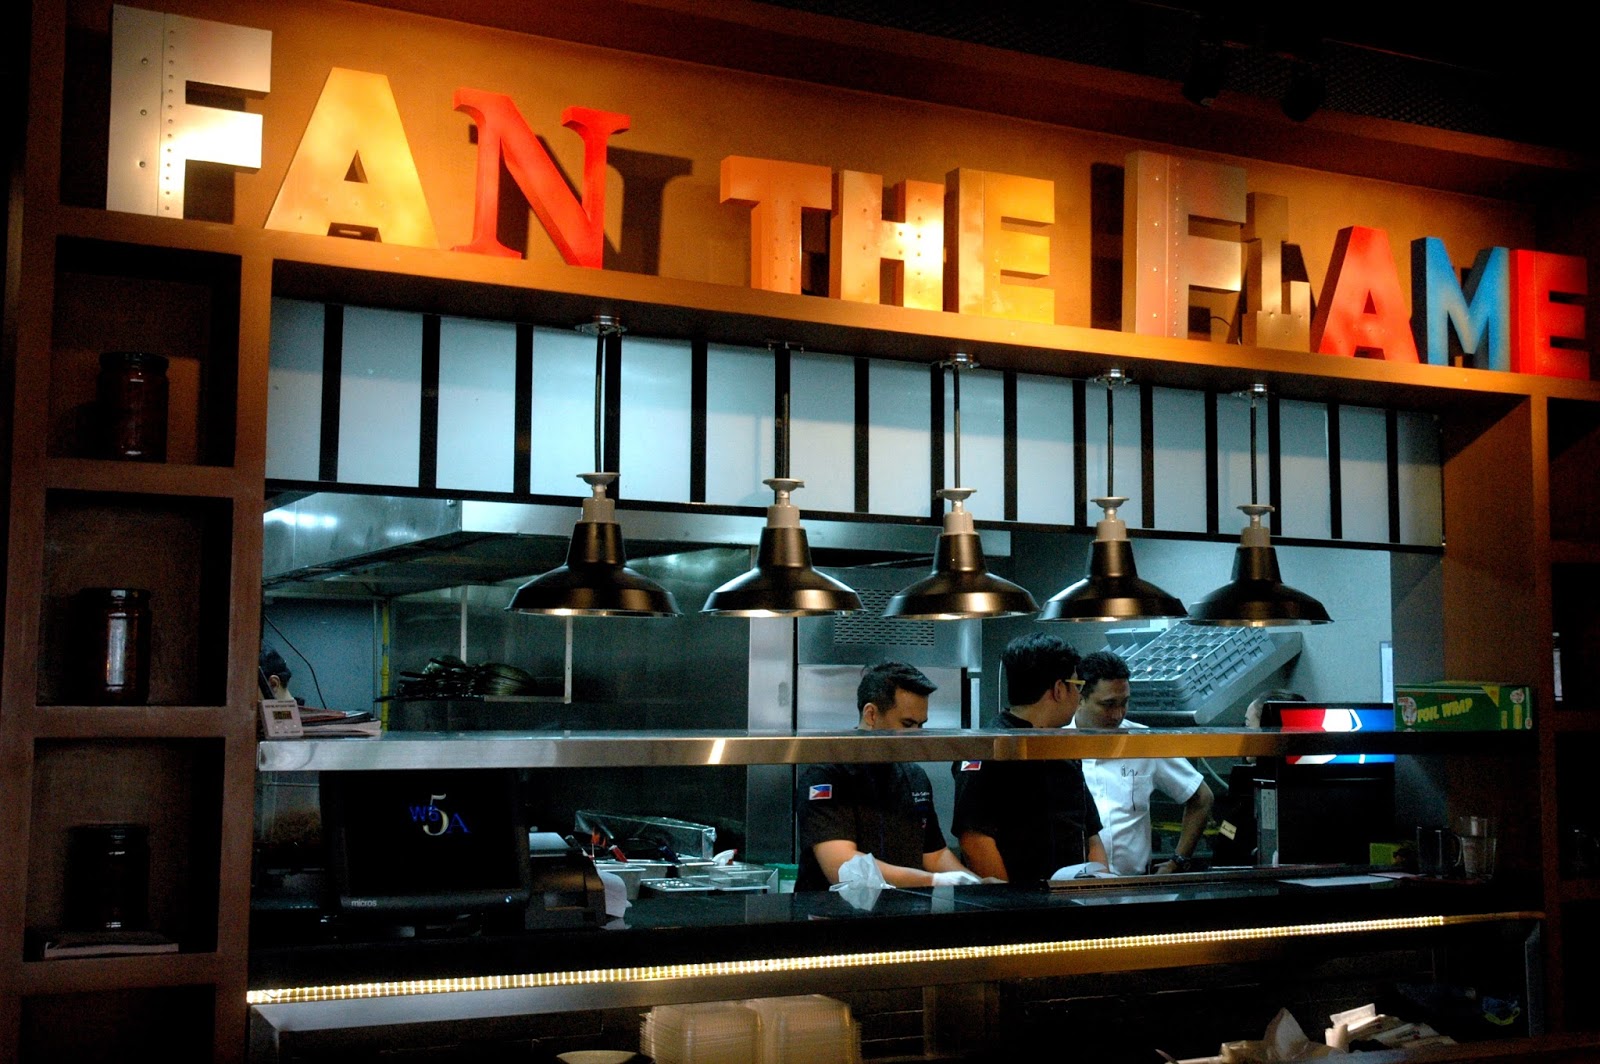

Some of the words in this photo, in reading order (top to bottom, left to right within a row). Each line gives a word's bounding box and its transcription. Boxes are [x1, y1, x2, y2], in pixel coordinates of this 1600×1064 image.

[106, 4, 630, 270] FAN
[719, 154, 1055, 326] THE
[1121, 150, 1588, 380] FLAME
[1441, 698, 1473, 717] WRAP
[351, 898, 377, 907] micros
